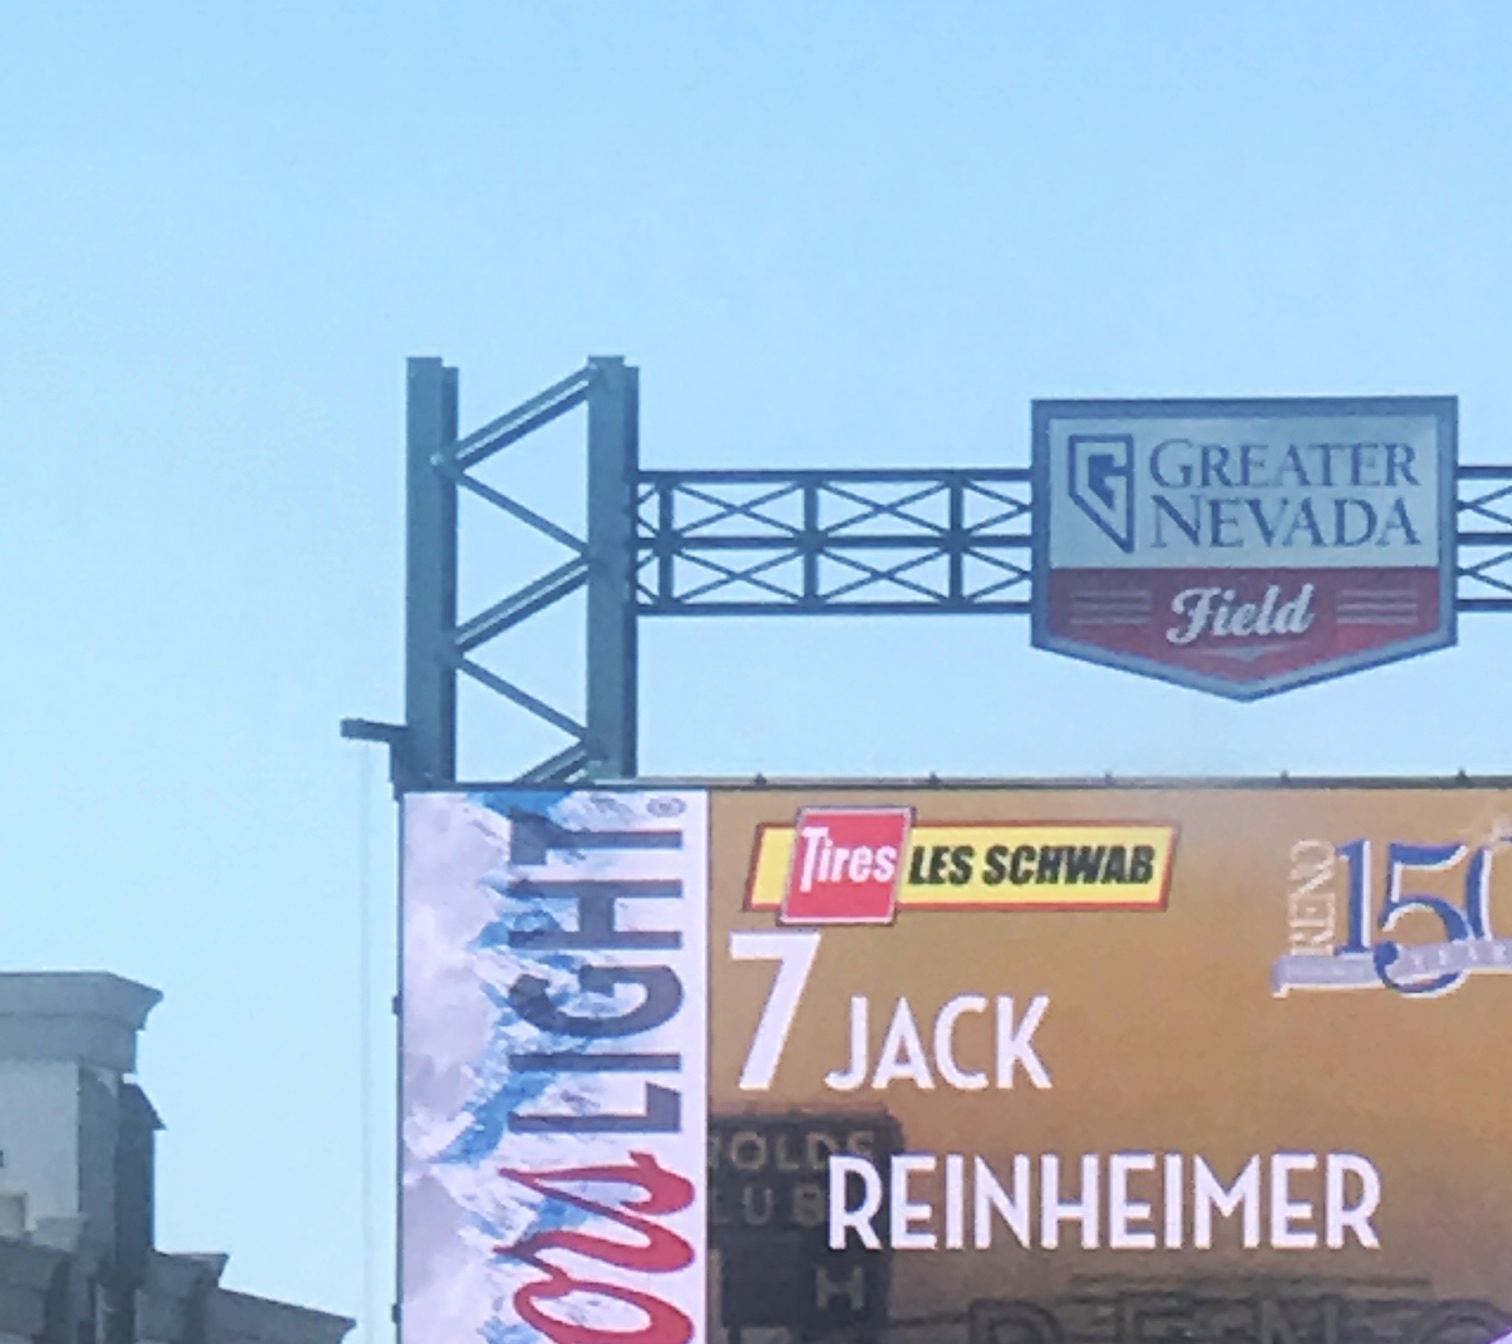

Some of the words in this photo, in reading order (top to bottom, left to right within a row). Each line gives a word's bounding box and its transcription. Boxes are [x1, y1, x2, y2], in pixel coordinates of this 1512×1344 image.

[1148, 438, 1421, 488] GREATER
[1150, 494, 1422, 548] NEVADA
[1166, 582, 1315, 645] Field
[801, 826, 897, 893] Tires
[908, 845, 975, 885] LES
[982, 845, 1156, 886] SCHWAB
[508, 810, 684, 1135] LIGHT
[729, 929, 822, 1090] 7
[824, 994, 1053, 1090] JACK
[828, 1151, 1383, 1250] REINHEIMER
